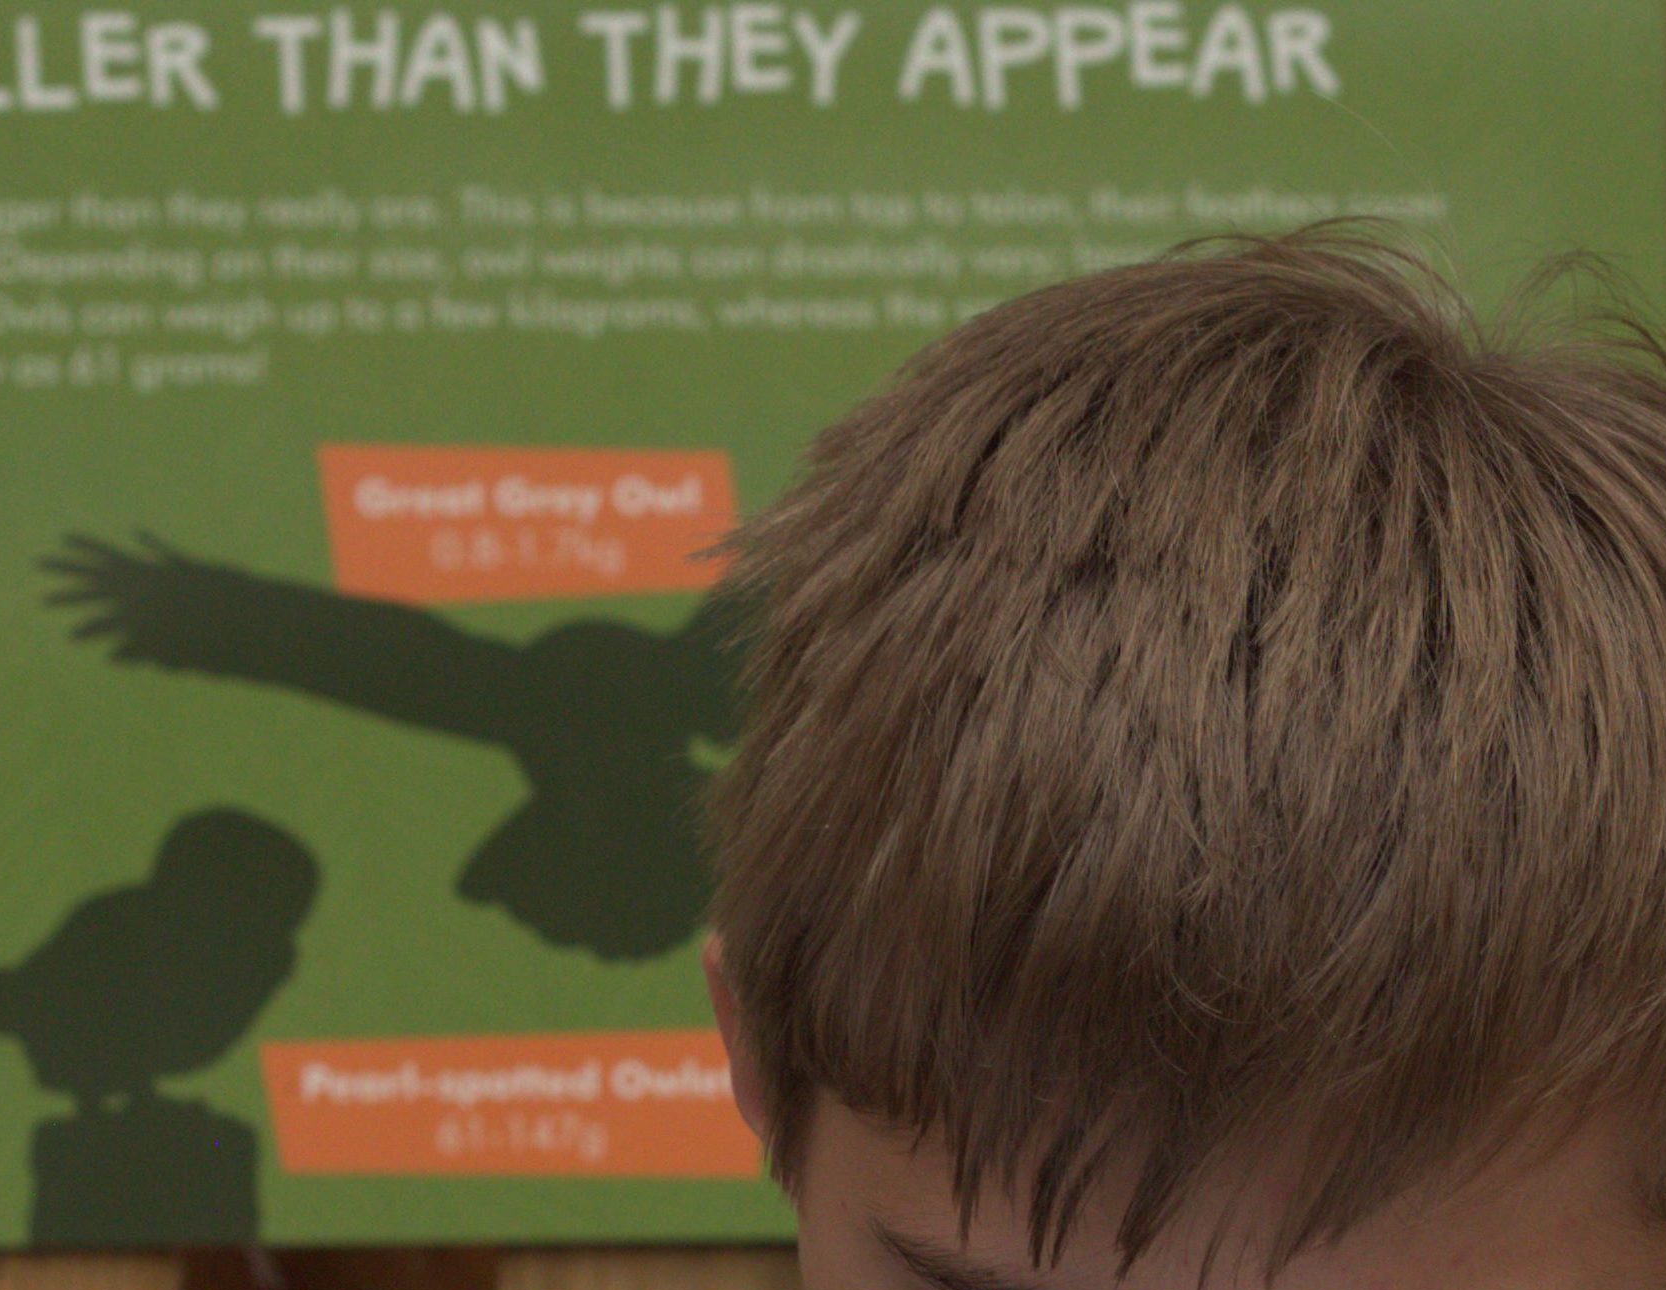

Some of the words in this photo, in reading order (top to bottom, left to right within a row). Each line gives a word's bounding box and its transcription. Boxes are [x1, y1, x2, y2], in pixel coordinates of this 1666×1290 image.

[253, 8, 545, 114] THAN
[578, 4, 860, 110] THEY
[897, 1, 1341, 110] APPEAR
[355, 477, 484, 517] Great
[494, 475, 600, 524] Grey
[613, 473, 704, 515] Owl
[301, 1059, 601, 1105] Pearl-spotted
